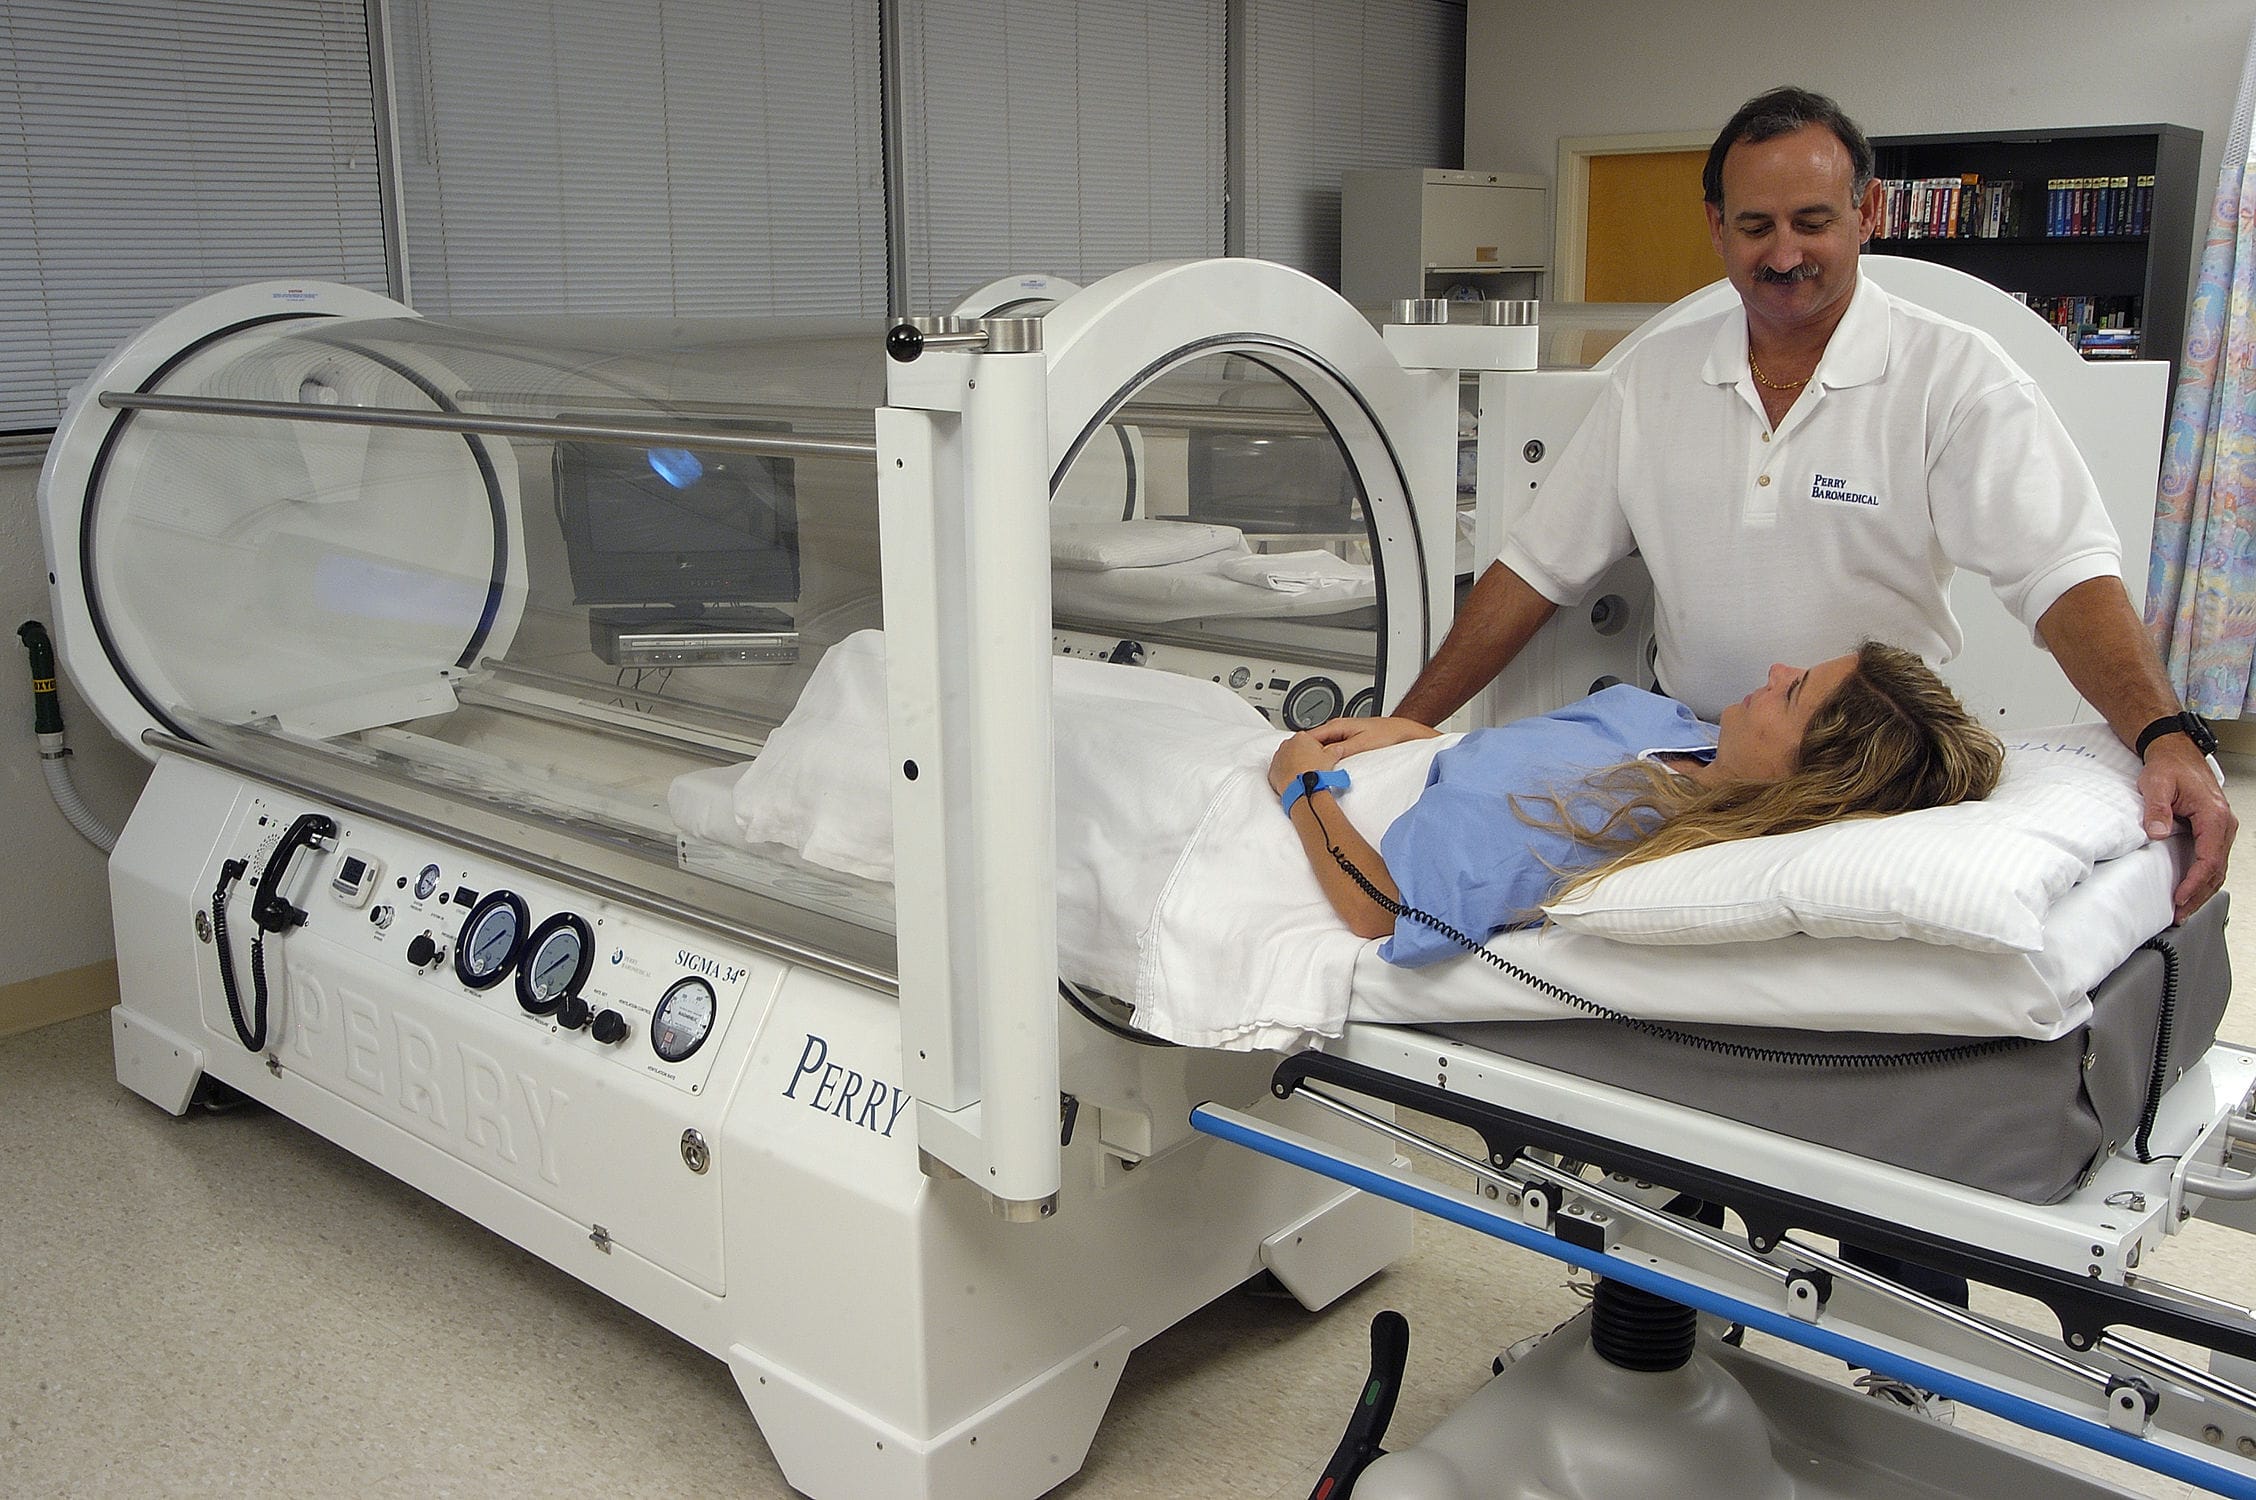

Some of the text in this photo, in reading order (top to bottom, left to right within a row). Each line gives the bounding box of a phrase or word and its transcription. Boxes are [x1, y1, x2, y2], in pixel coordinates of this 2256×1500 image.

[1811, 486, 1879, 506] BAROMEDICAL
[1814, 474, 1847, 489] PERRY
[674, 949, 740, 985] SIGMA 34
[287, 963, 570, 1187] PERRY
[782, 1033, 912, 1138] PERRY
